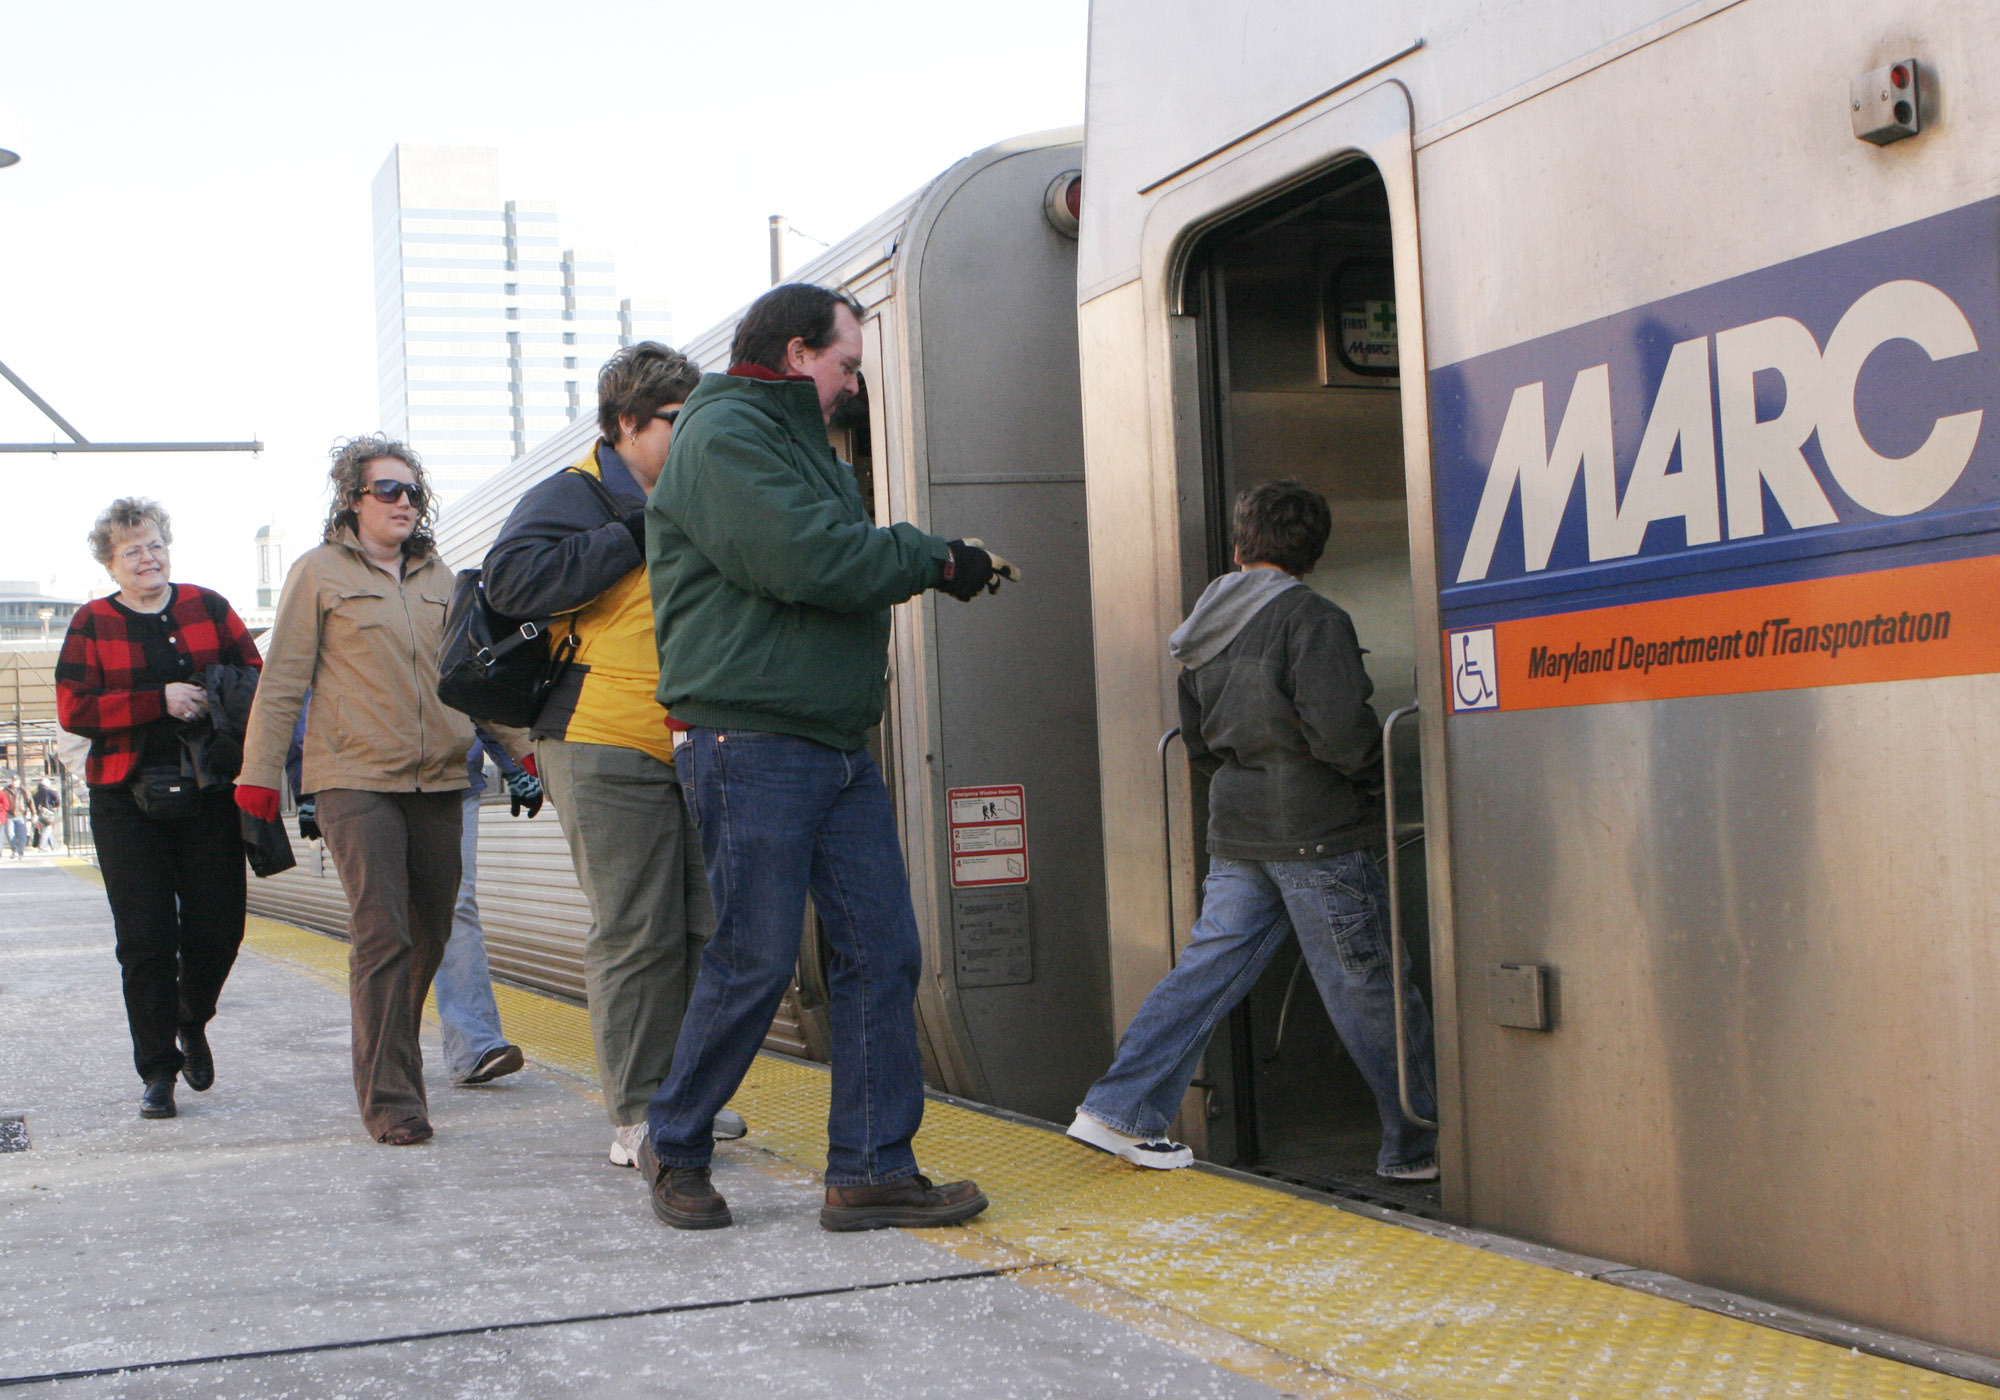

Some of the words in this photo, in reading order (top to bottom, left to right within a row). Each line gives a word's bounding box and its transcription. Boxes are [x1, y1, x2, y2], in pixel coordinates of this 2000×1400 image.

[1349, 341, 1390, 354] MARC
[1456, 279, 1984, 584] MARC
[1528, 638, 1616, 683] Maryland
[1618, 629, 1743, 675] Department
[1745, 620, 1770, 658] of
[1770, 610, 1951, 658] Transportation
